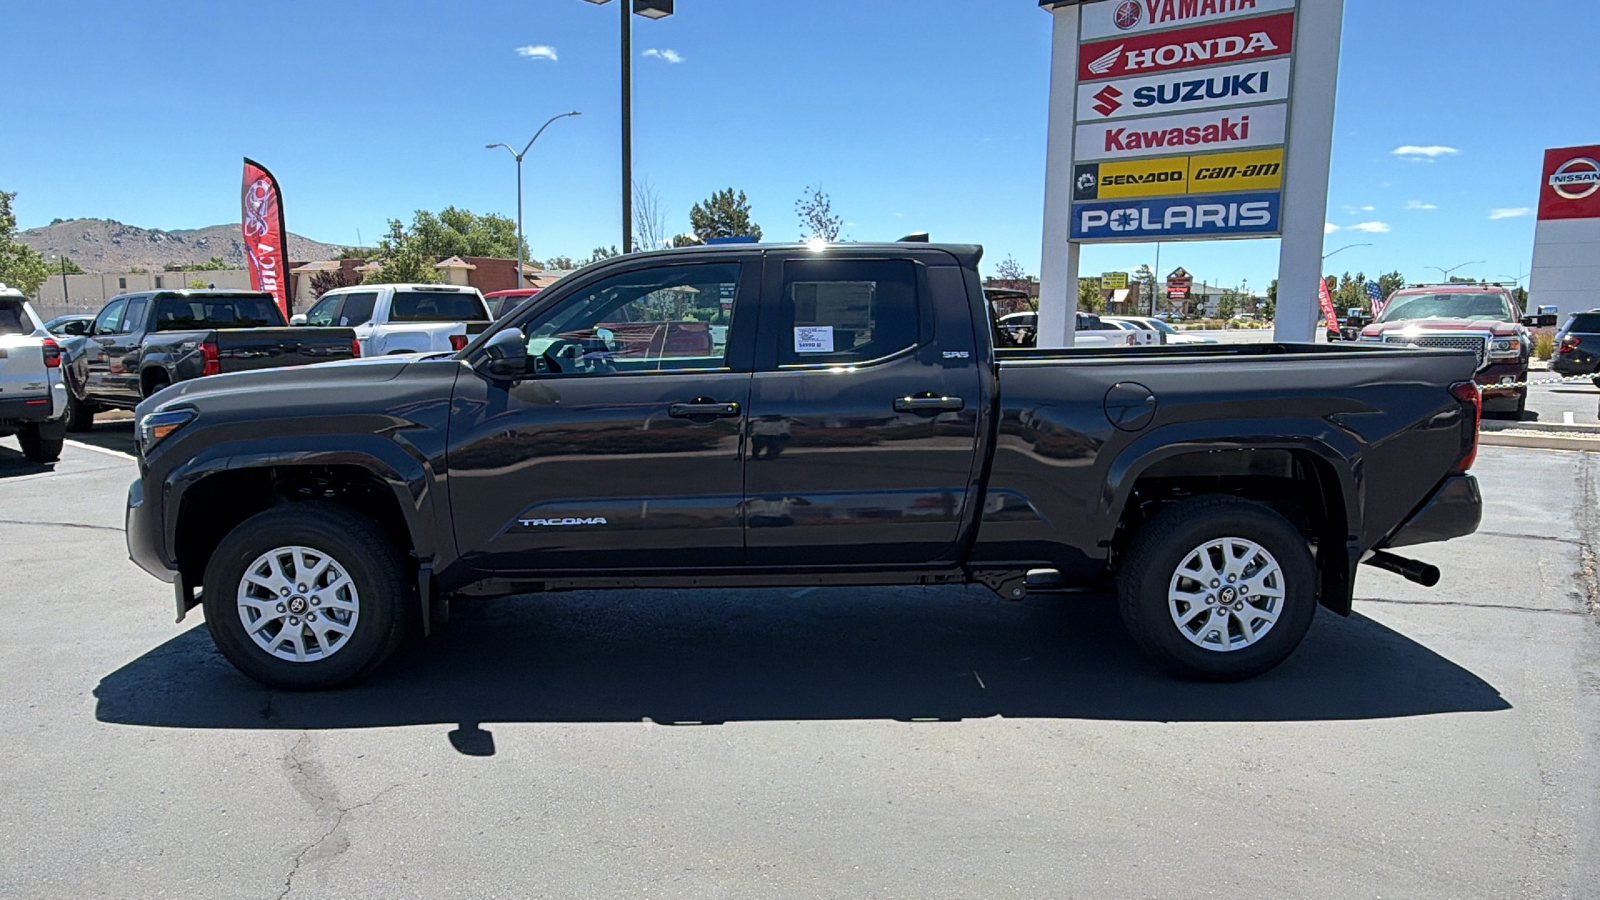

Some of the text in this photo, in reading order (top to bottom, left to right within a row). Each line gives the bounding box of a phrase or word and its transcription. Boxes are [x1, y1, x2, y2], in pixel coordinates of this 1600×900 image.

[1124, 31, 1278, 71] HONDA
[1133, 71, 1270, 108] SUZUKI
[1105, 115, 1250, 152] Kawasaki
[1554, 173, 1600, 183] NISSAN
[1080, 201, 1271, 233] POLARIS
[518, 517, 607, 526] TACOMA
